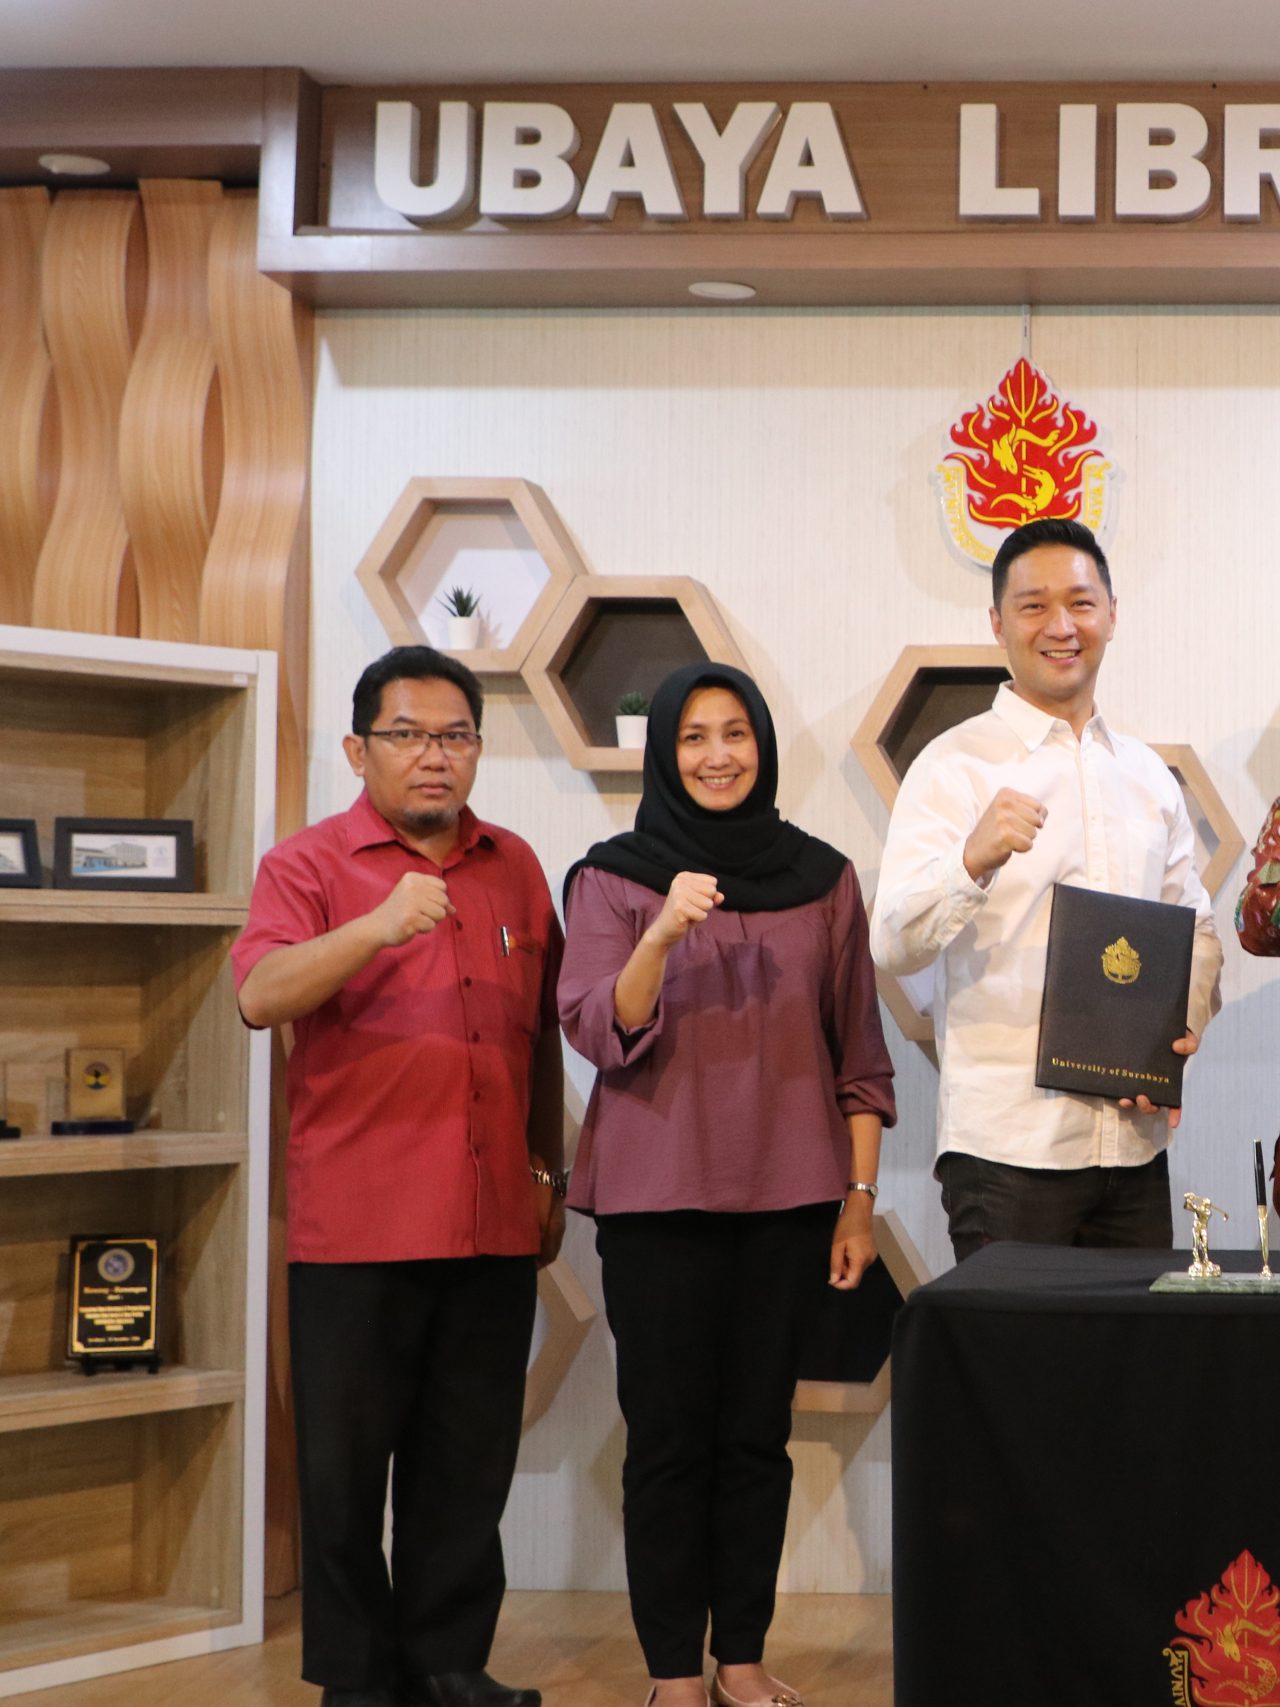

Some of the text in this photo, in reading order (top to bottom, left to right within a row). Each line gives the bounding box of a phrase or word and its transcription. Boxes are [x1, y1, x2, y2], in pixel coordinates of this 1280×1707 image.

[374, 101, 868, 222] UBAYA
[1051, 1057, 1169, 1084] University of Surabaya
